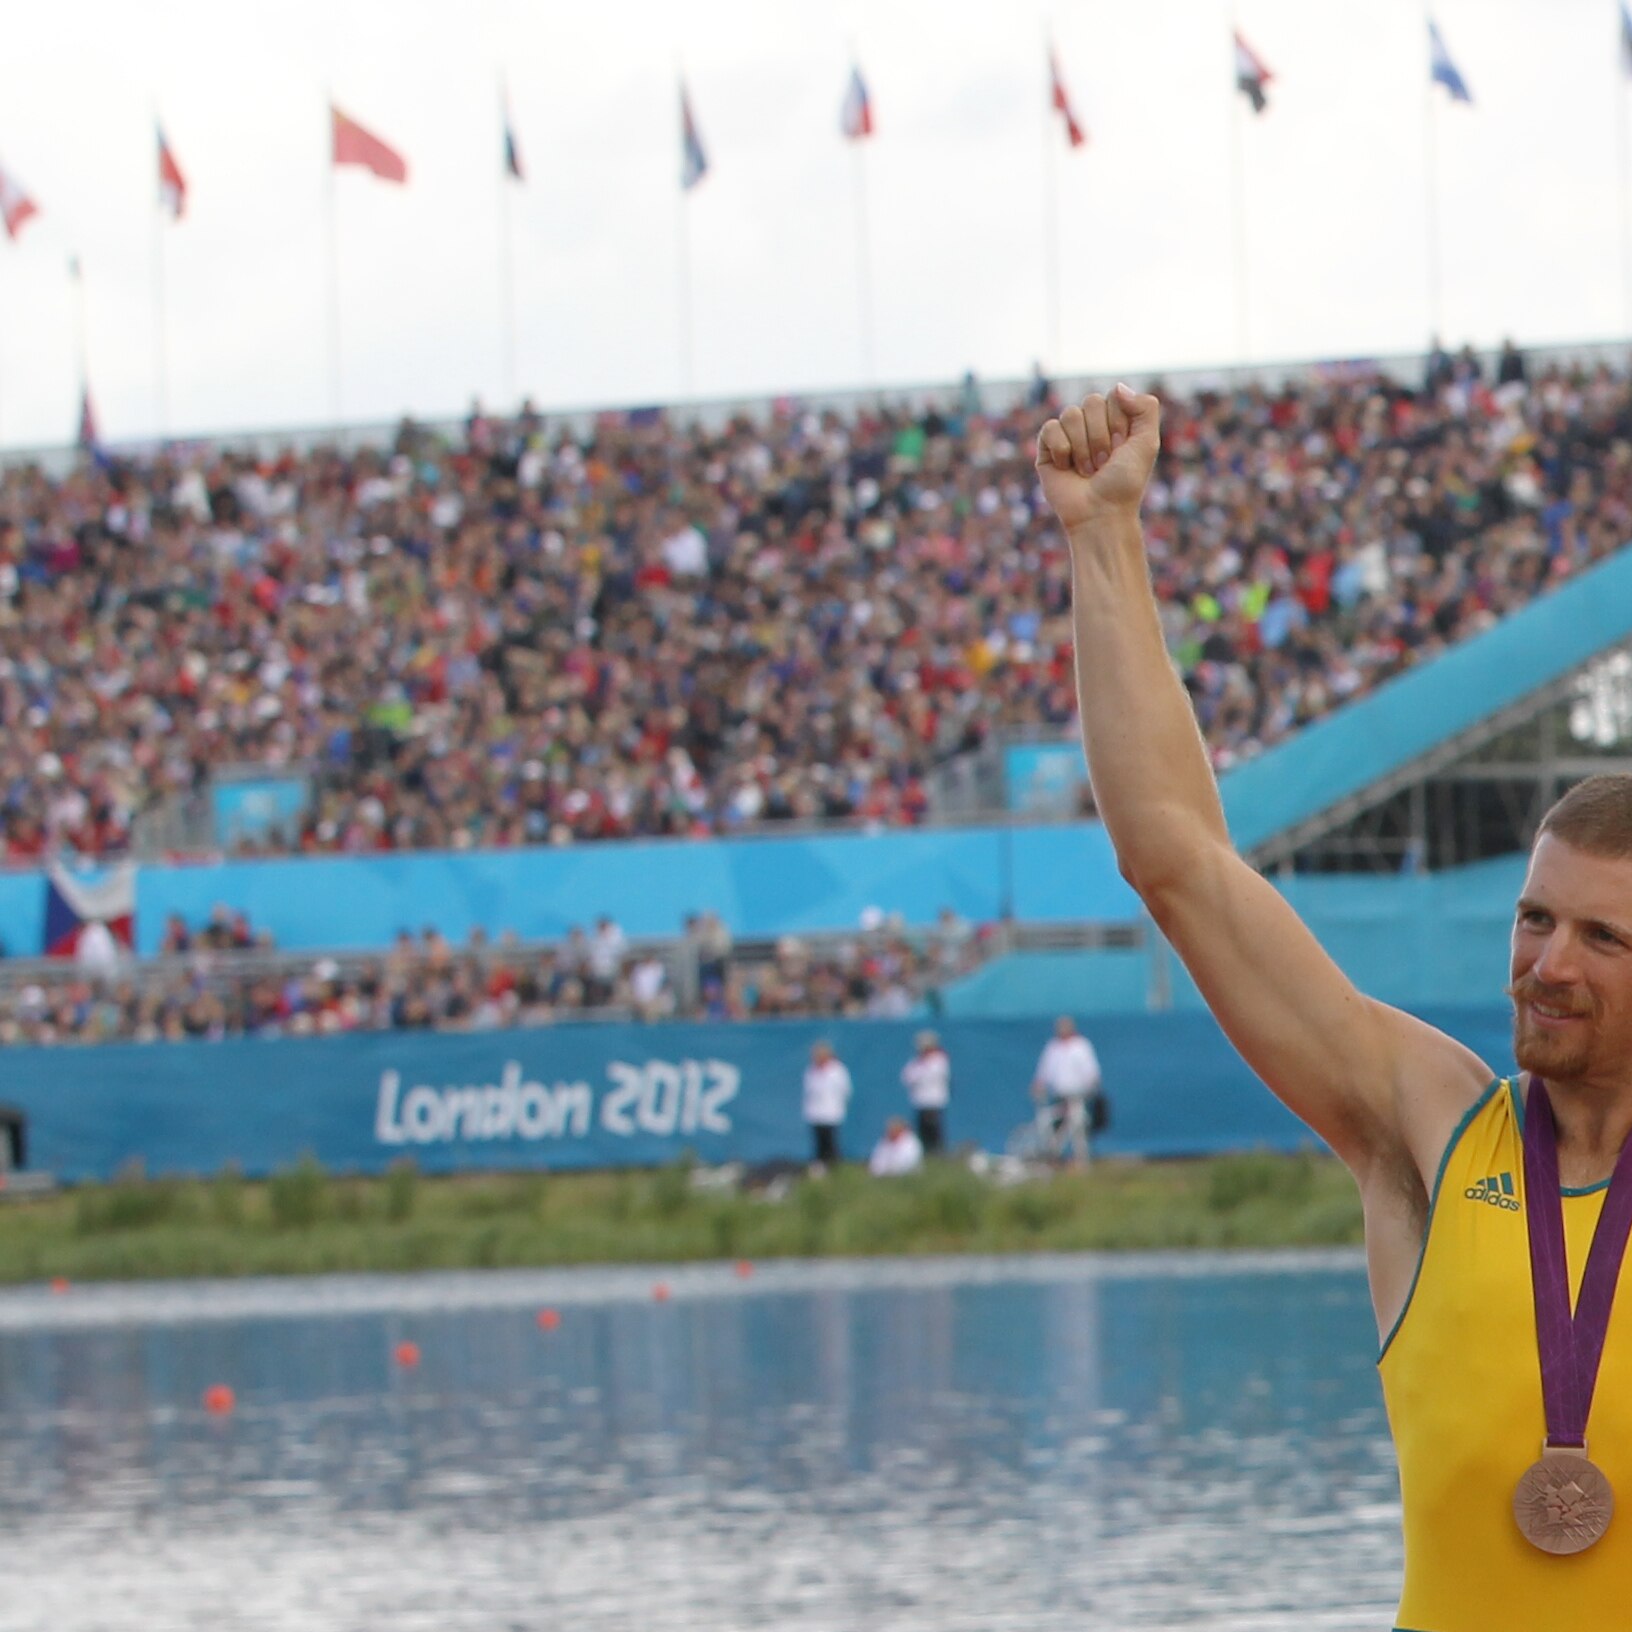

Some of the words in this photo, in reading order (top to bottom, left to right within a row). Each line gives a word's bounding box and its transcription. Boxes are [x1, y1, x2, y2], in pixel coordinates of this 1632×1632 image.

[374, 1059, 593, 1145] London
[602, 1057, 741, 1137] 2012
[1464, 1187, 1521, 1211] adidas
